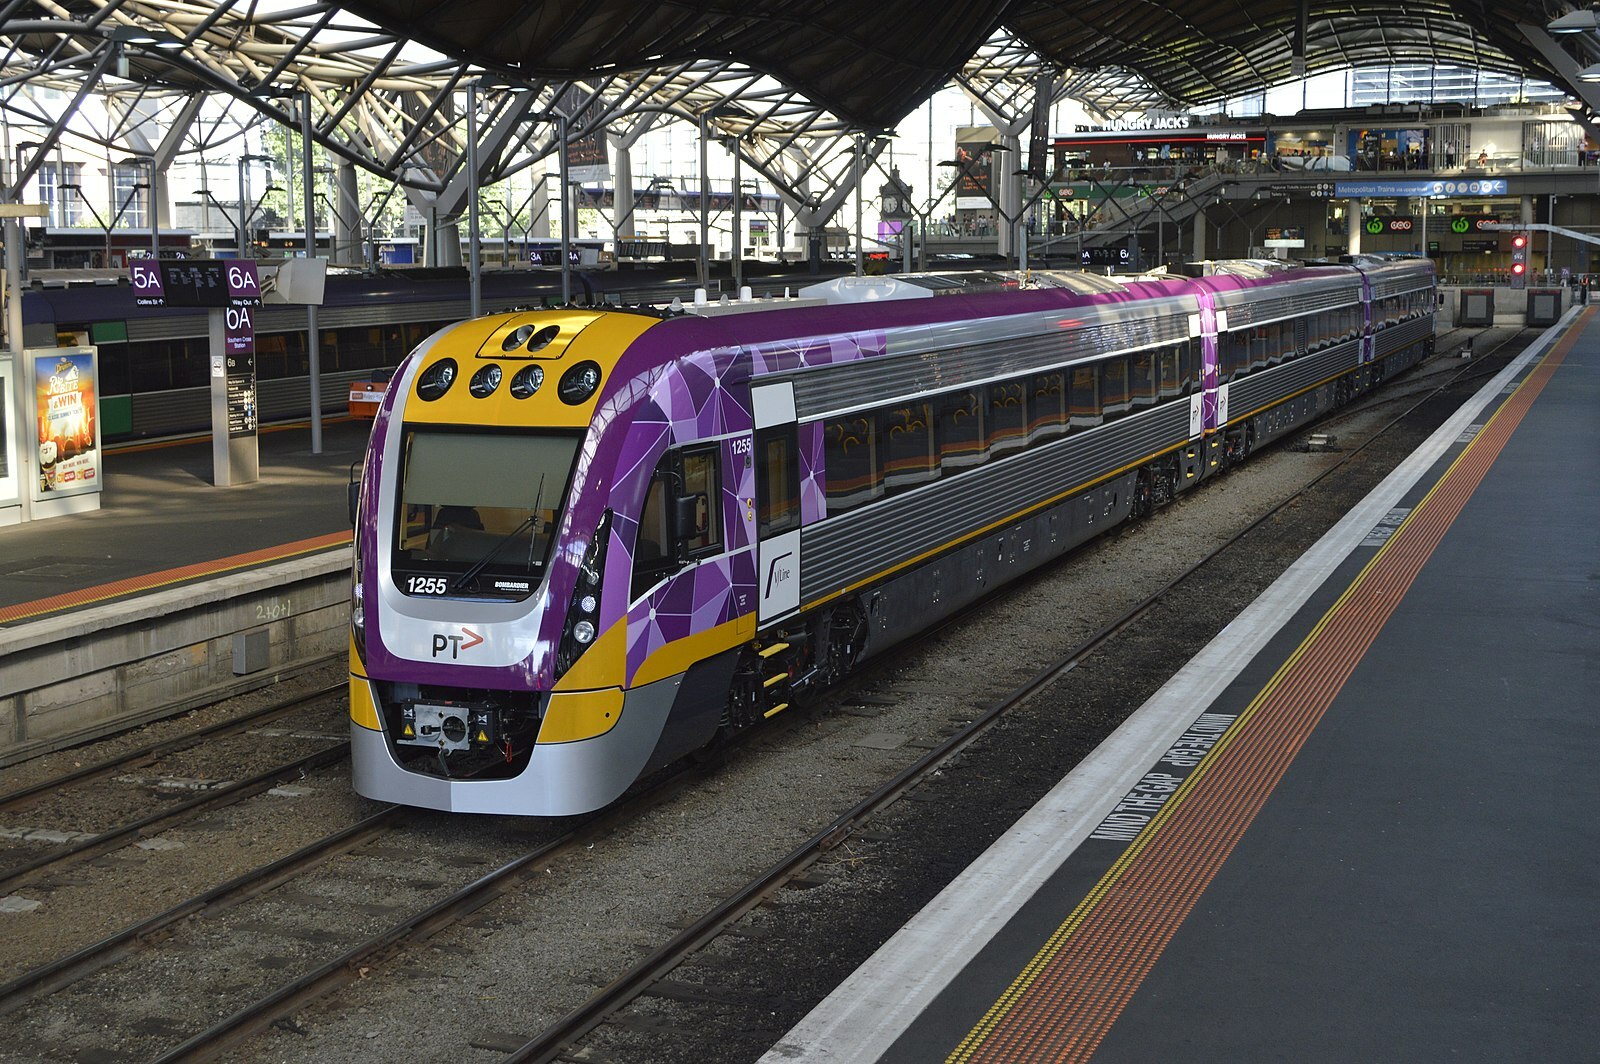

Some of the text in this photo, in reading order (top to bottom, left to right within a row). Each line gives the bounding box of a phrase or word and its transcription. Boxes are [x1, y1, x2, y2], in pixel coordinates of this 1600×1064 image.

[1102, 118, 1153, 132] HUNGRY
[1338, 185, 1376, 194] Metropolitan
[1377, 185, 1395, 193] Trains
[530, 251, 541, 261] 3A
[134, 267, 160, 289] 5A
[229, 266, 256, 289] 6A
[226, 307, 251, 330] 6A
[732, 438, 751, 455] 1255
[407, 576, 448, 595] 1255
[494, 581, 530, 589] BOMBARDIER
[1089, 772, 1184, 842] MIND THE GAP
